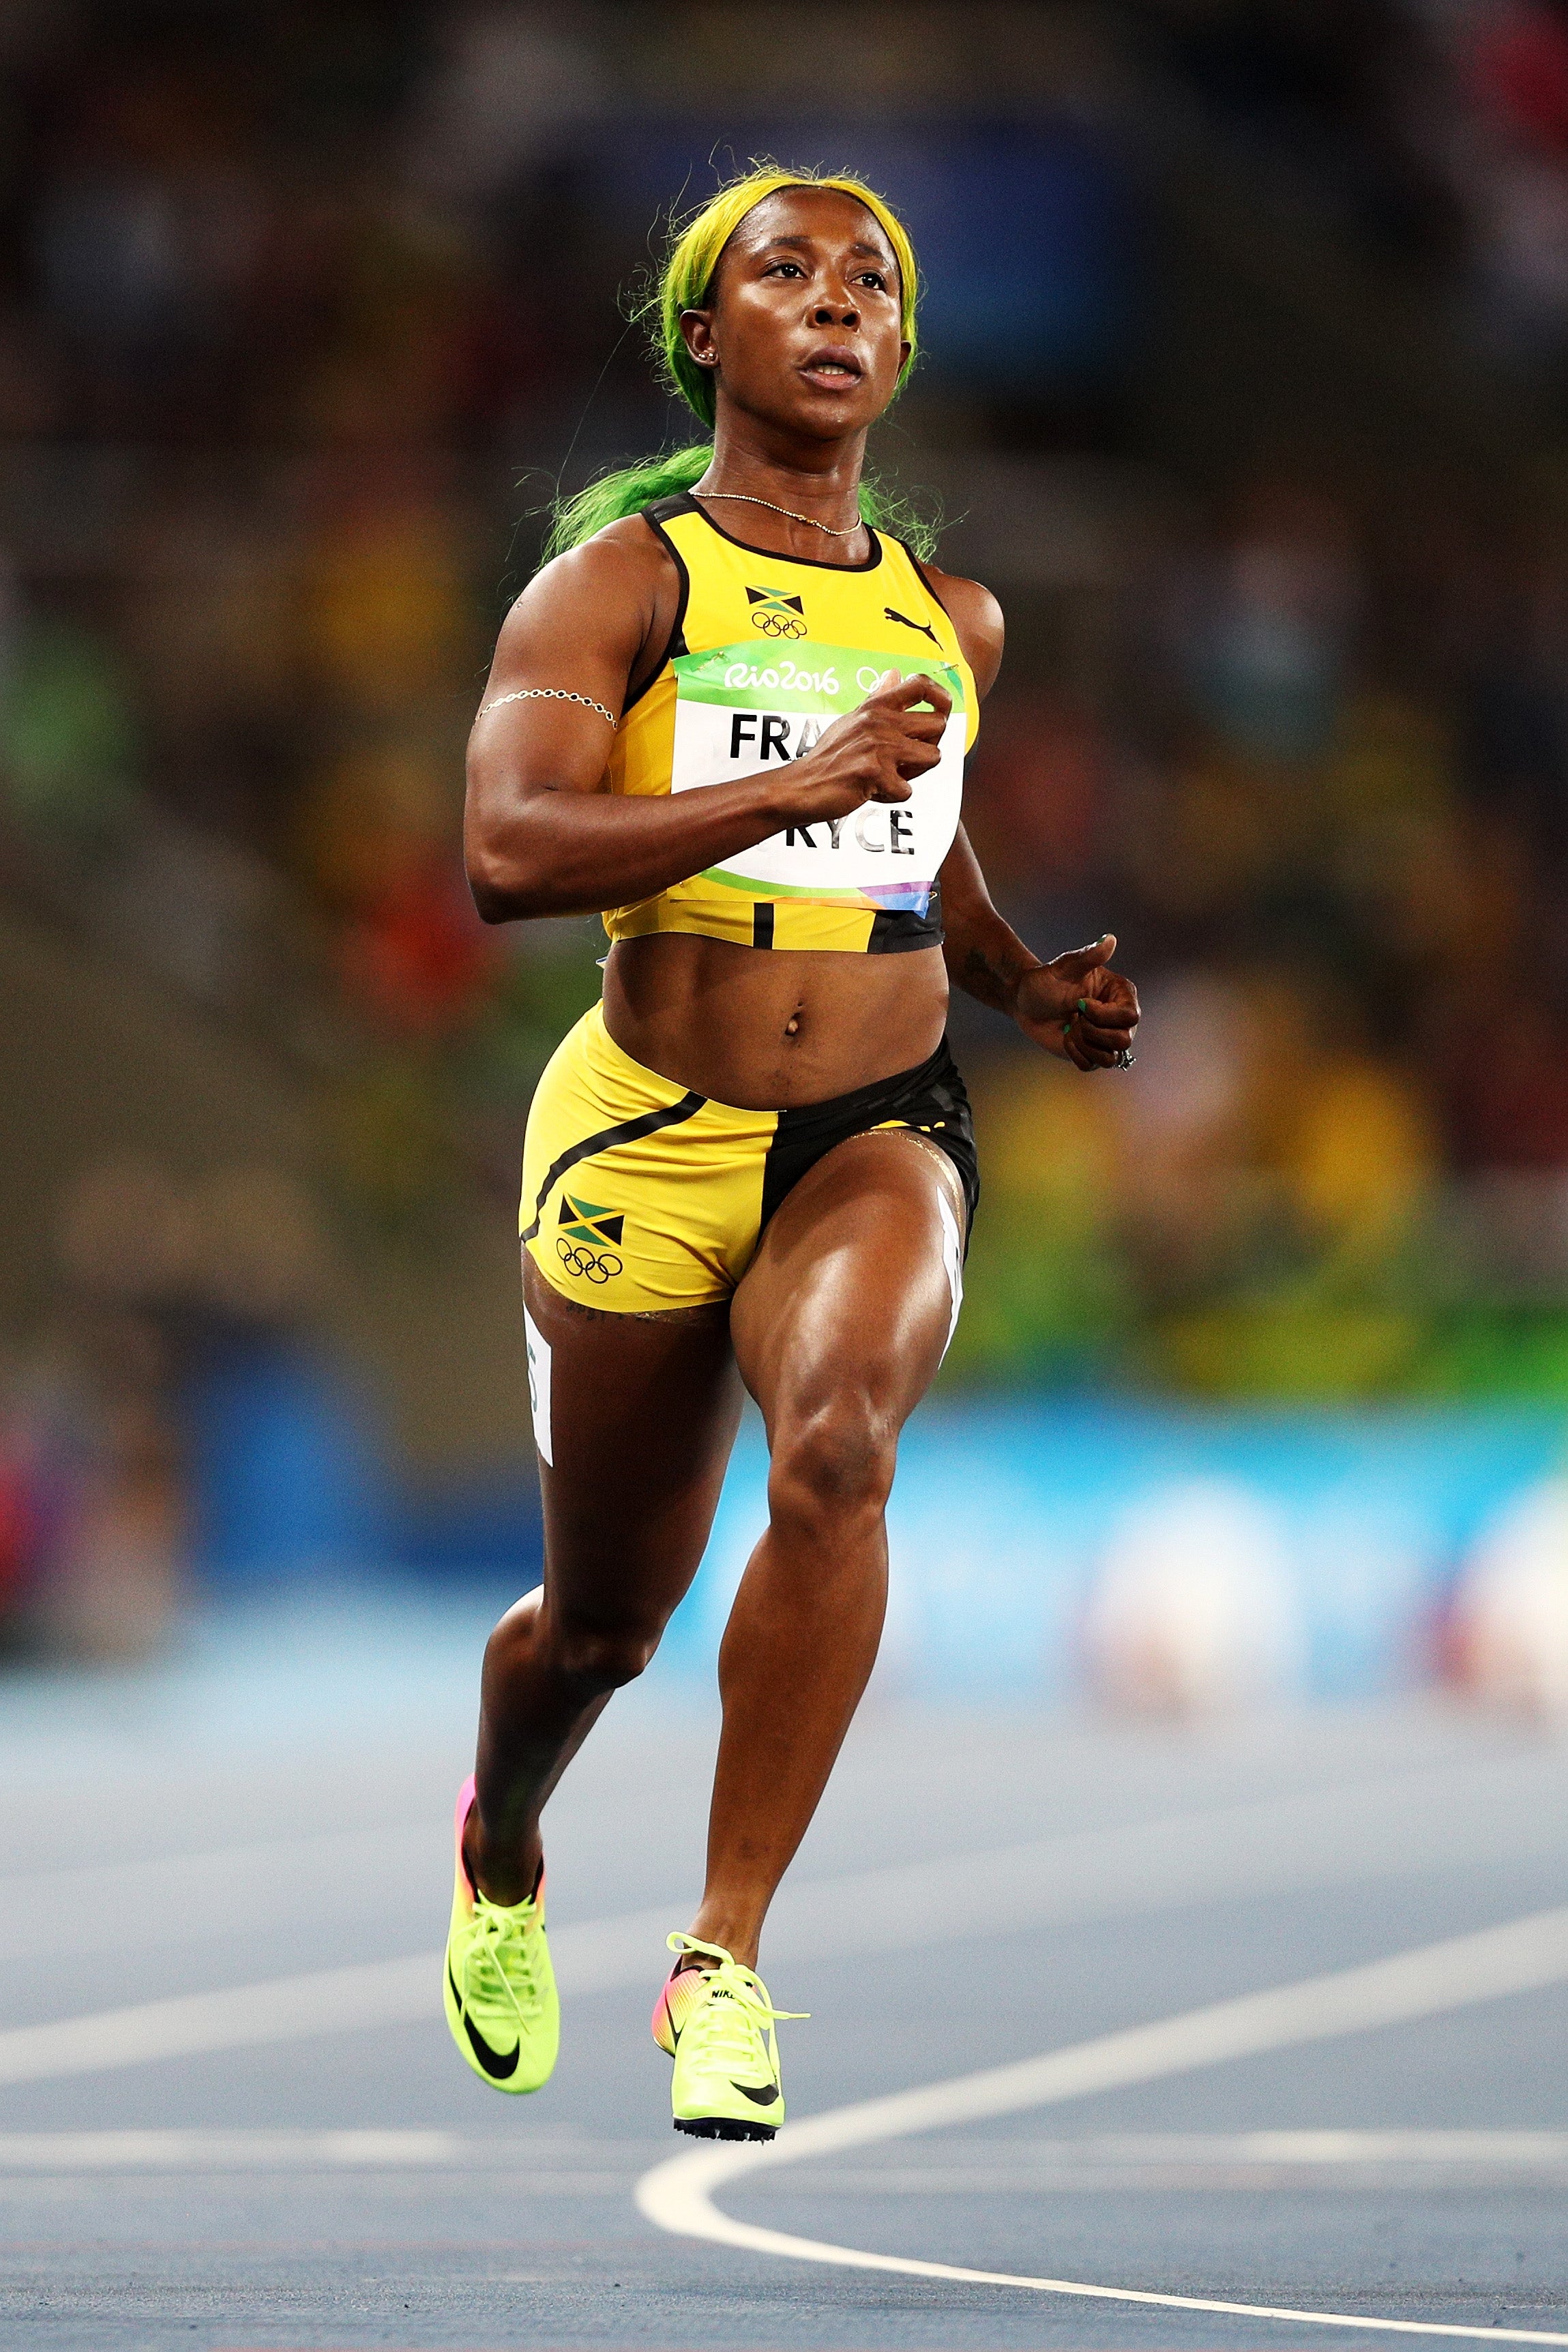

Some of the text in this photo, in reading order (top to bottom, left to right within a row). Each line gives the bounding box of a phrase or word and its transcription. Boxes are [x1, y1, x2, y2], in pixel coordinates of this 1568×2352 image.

[724, 661, 840, 694] Rio2016
[730, 714, 822, 761] FRA
[786, 808, 915, 855] RYCE
